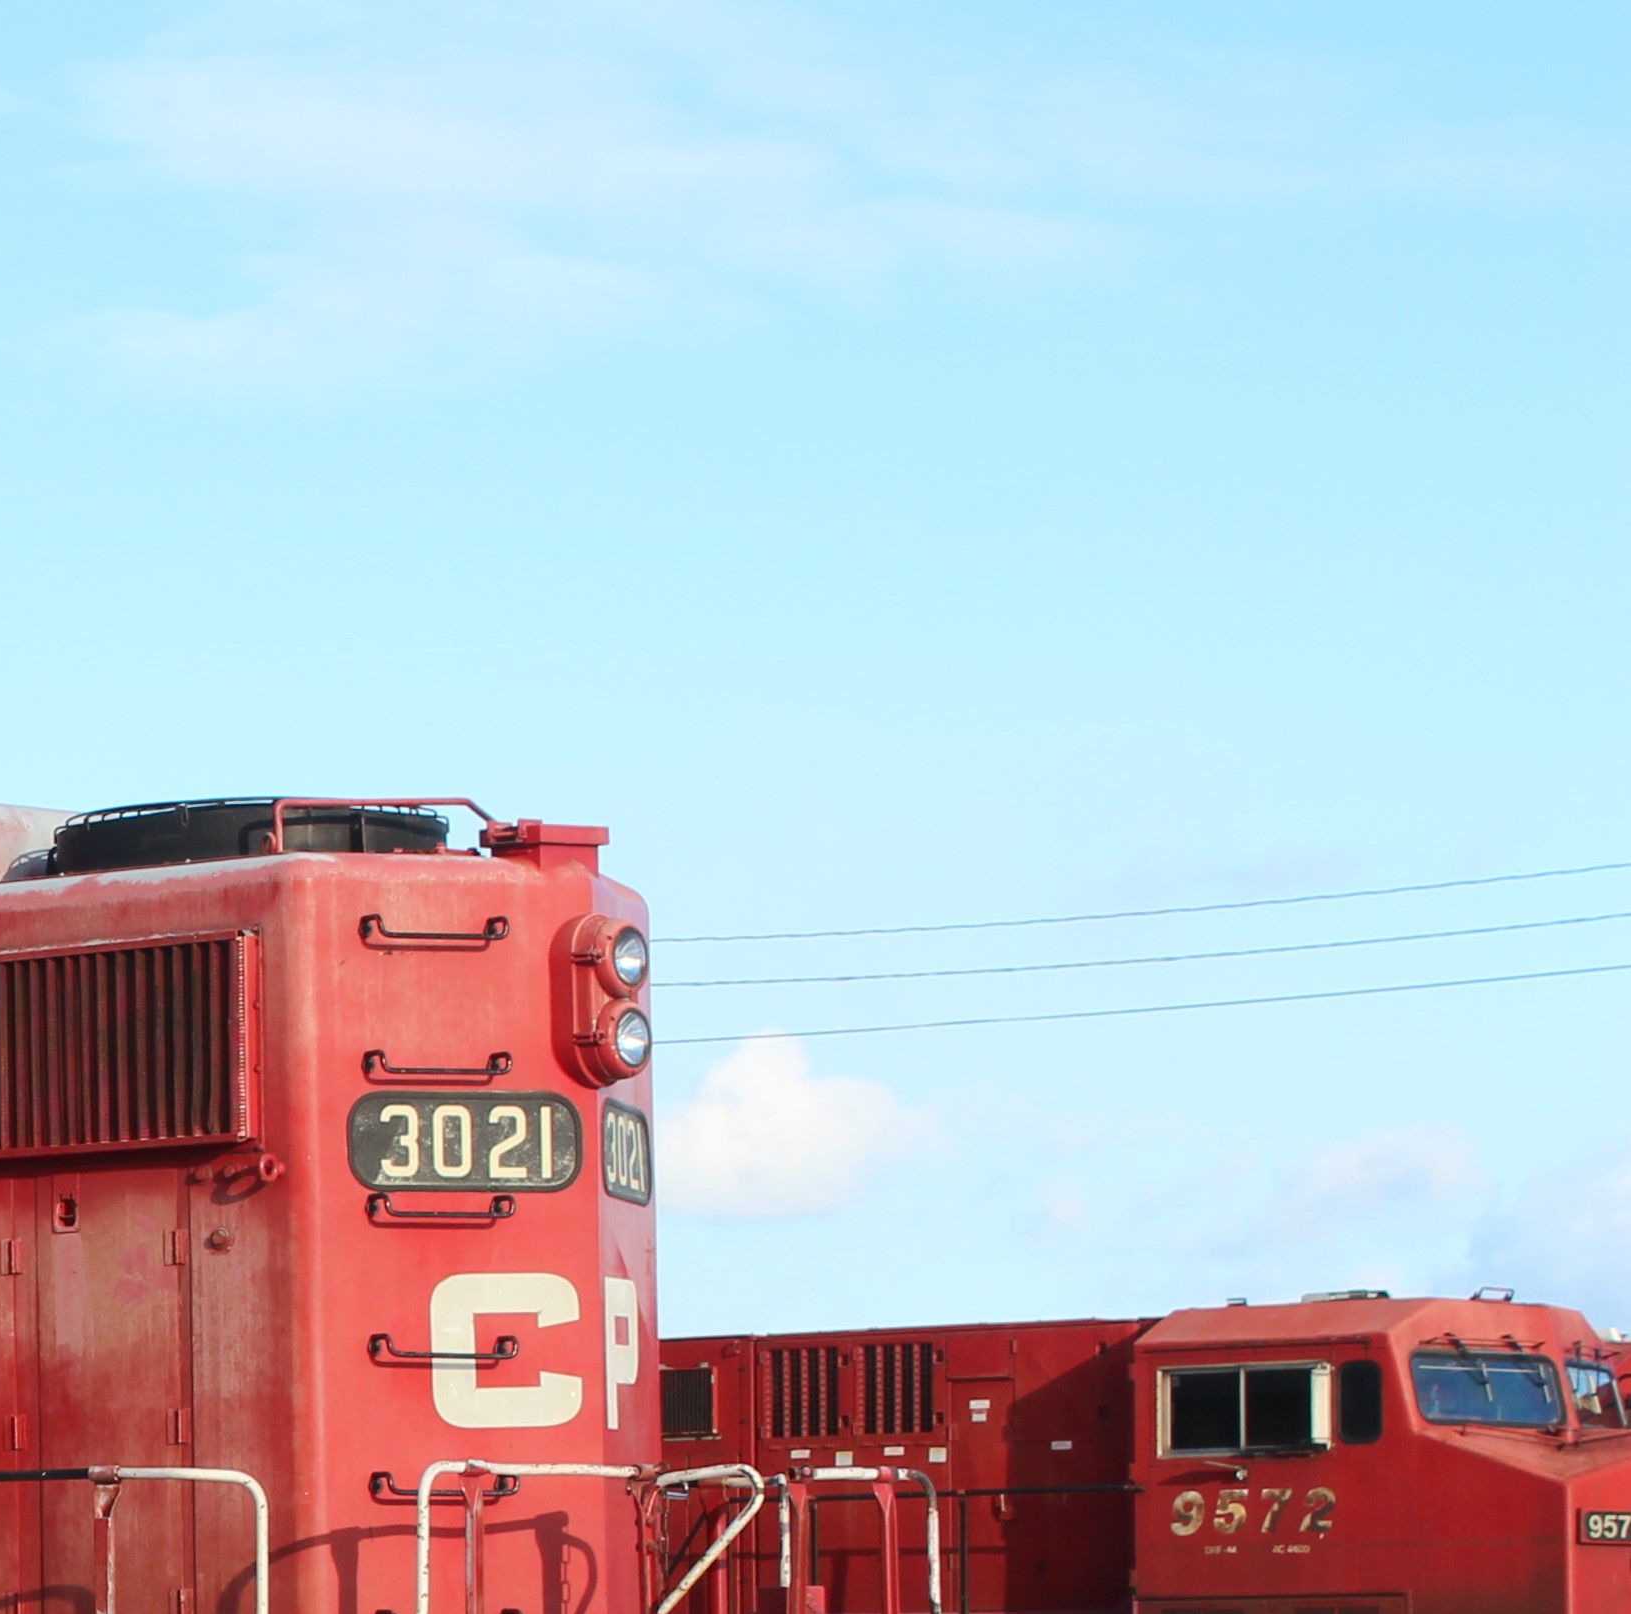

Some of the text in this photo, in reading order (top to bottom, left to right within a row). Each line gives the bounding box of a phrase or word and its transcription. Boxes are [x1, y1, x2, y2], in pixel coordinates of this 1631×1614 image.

[379, 1103, 553, 1179] 3021
[606, 1110, 646, 1193] 3021
[1170, 1487, 1337, 1537] 9572
